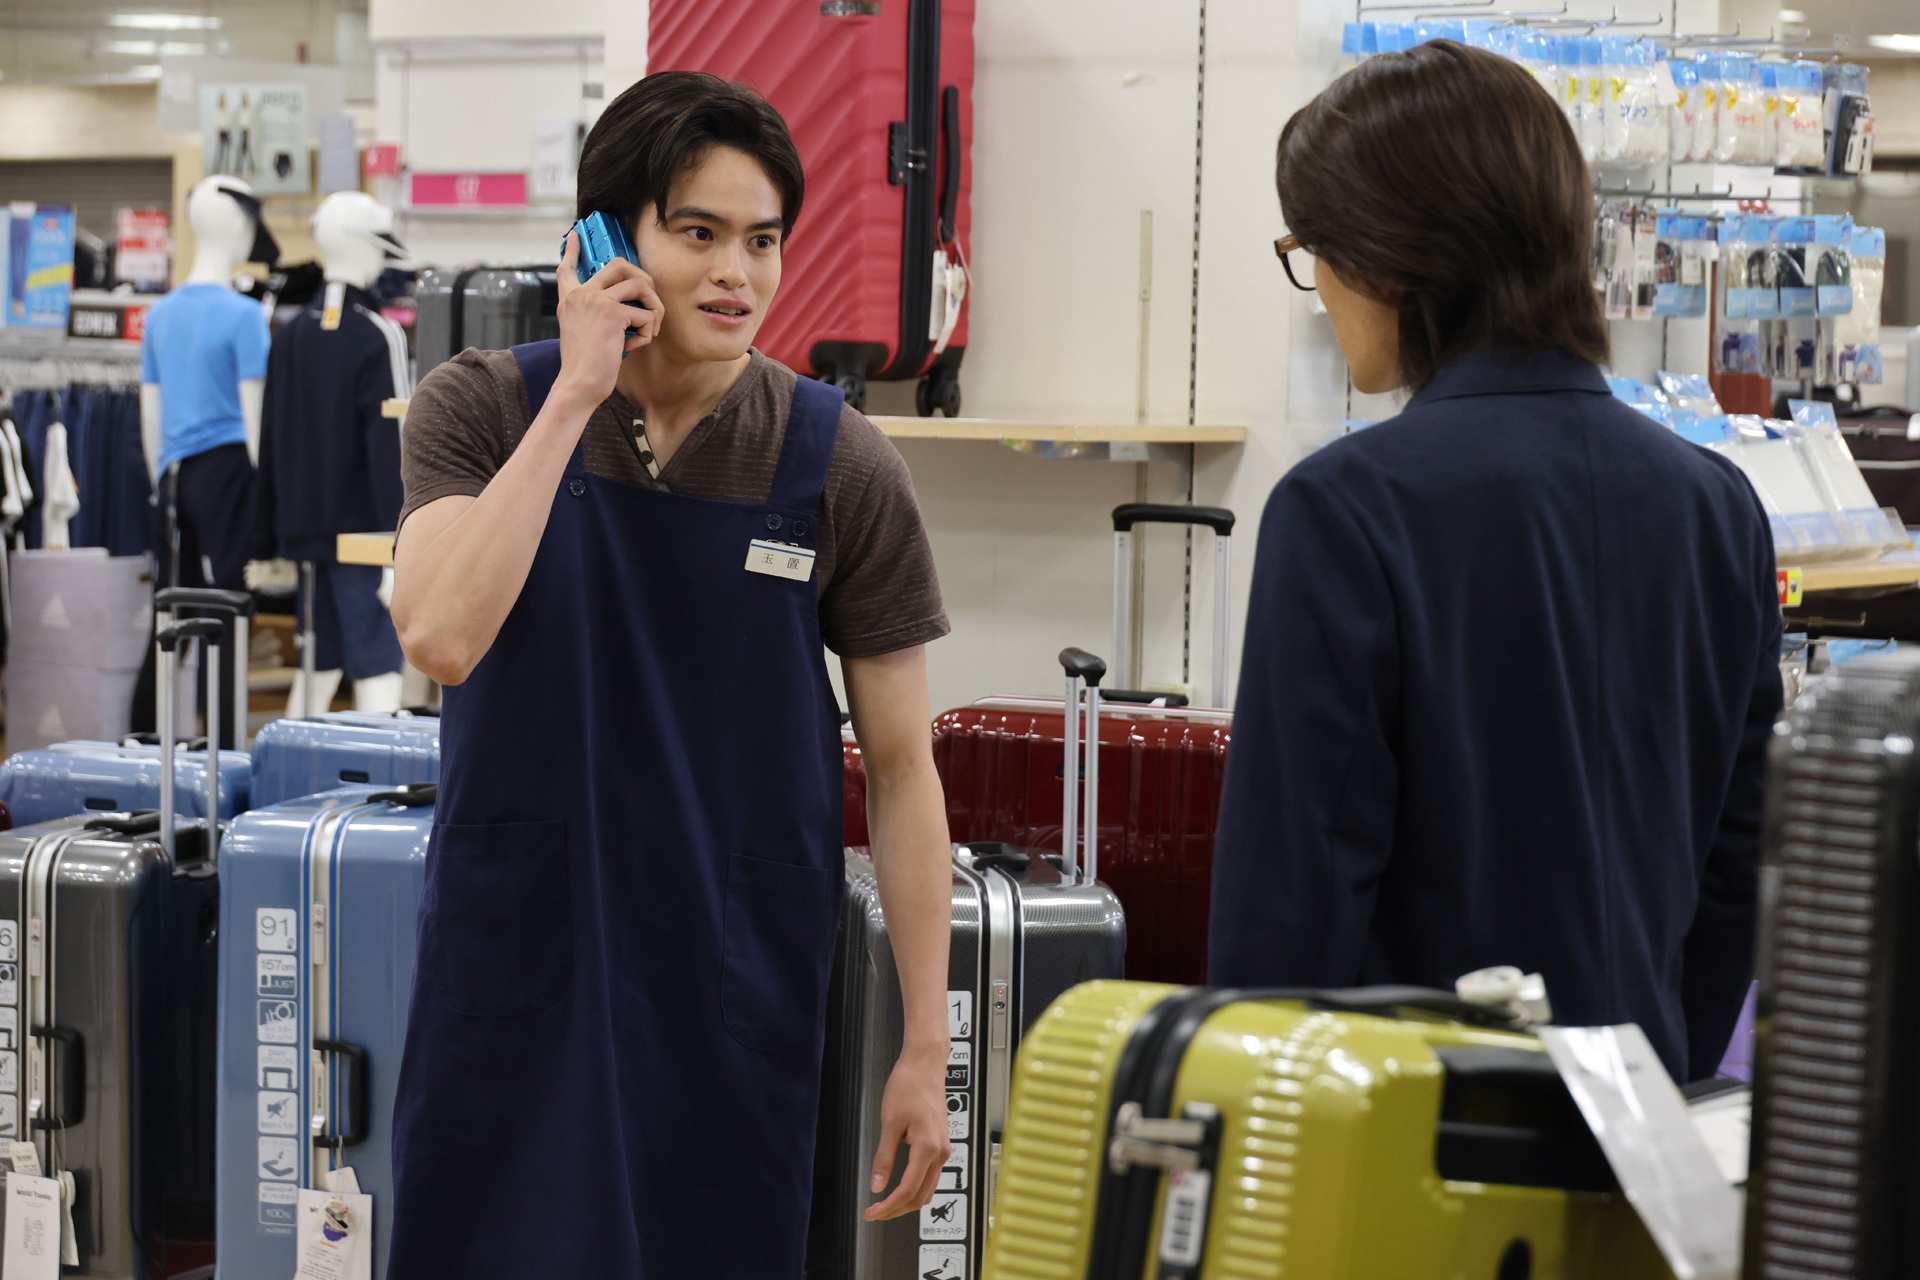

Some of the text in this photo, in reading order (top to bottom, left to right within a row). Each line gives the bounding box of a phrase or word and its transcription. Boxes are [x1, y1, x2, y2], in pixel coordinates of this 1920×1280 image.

[261, 916, 288, 936] 91
[261, 960, 296, 972] 157cm
[922, 1227, 965, 1236] 静音キャスター
